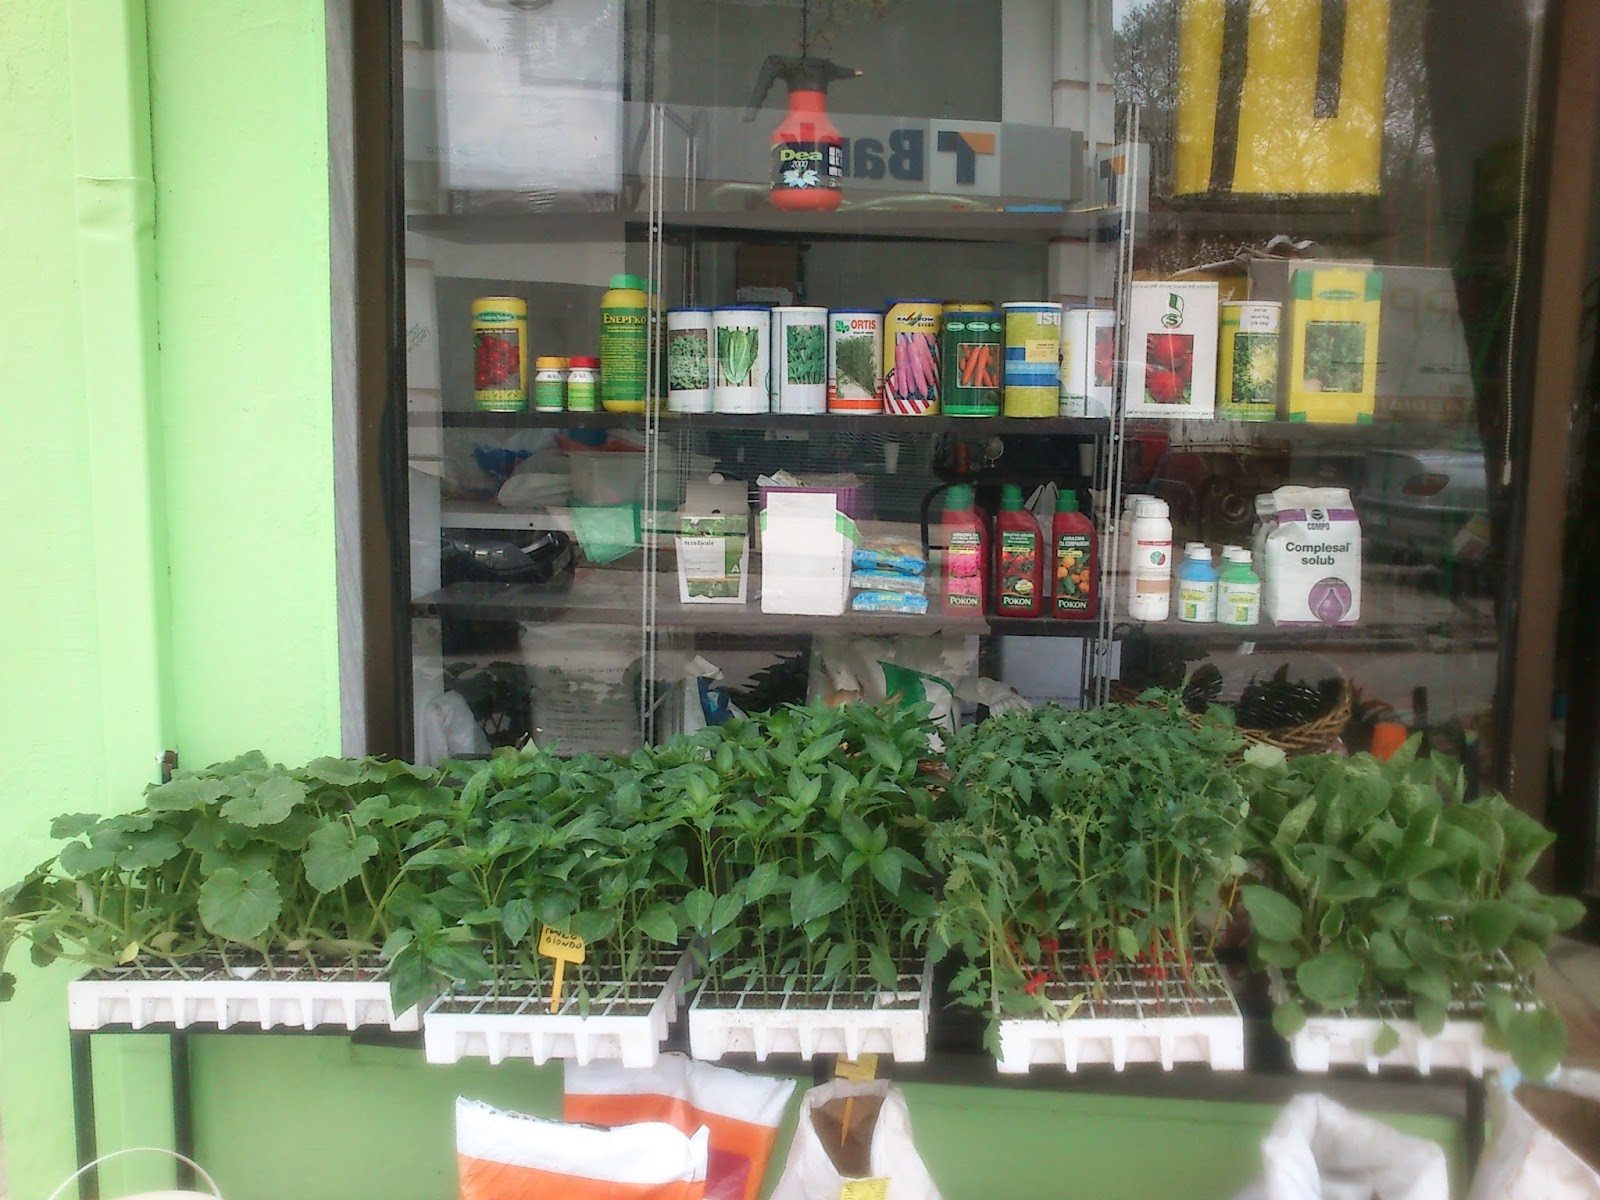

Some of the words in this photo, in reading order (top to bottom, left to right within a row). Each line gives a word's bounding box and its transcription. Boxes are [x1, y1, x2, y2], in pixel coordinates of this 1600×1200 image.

[780, 149, 824, 161] Dea
[791, 160, 809, 170] 2000
[851, 319, 876, 330] ORTIS
[1307, 522, 1330, 531] COMPO
[1285, 541, 1350, 555] Complesal
[1301, 555, 1336, 566] solub
[950, 597, 978, 606] POKON
[1003, 596, 1032, 606] POKON
[1058, 600, 1087, 609] POKON
